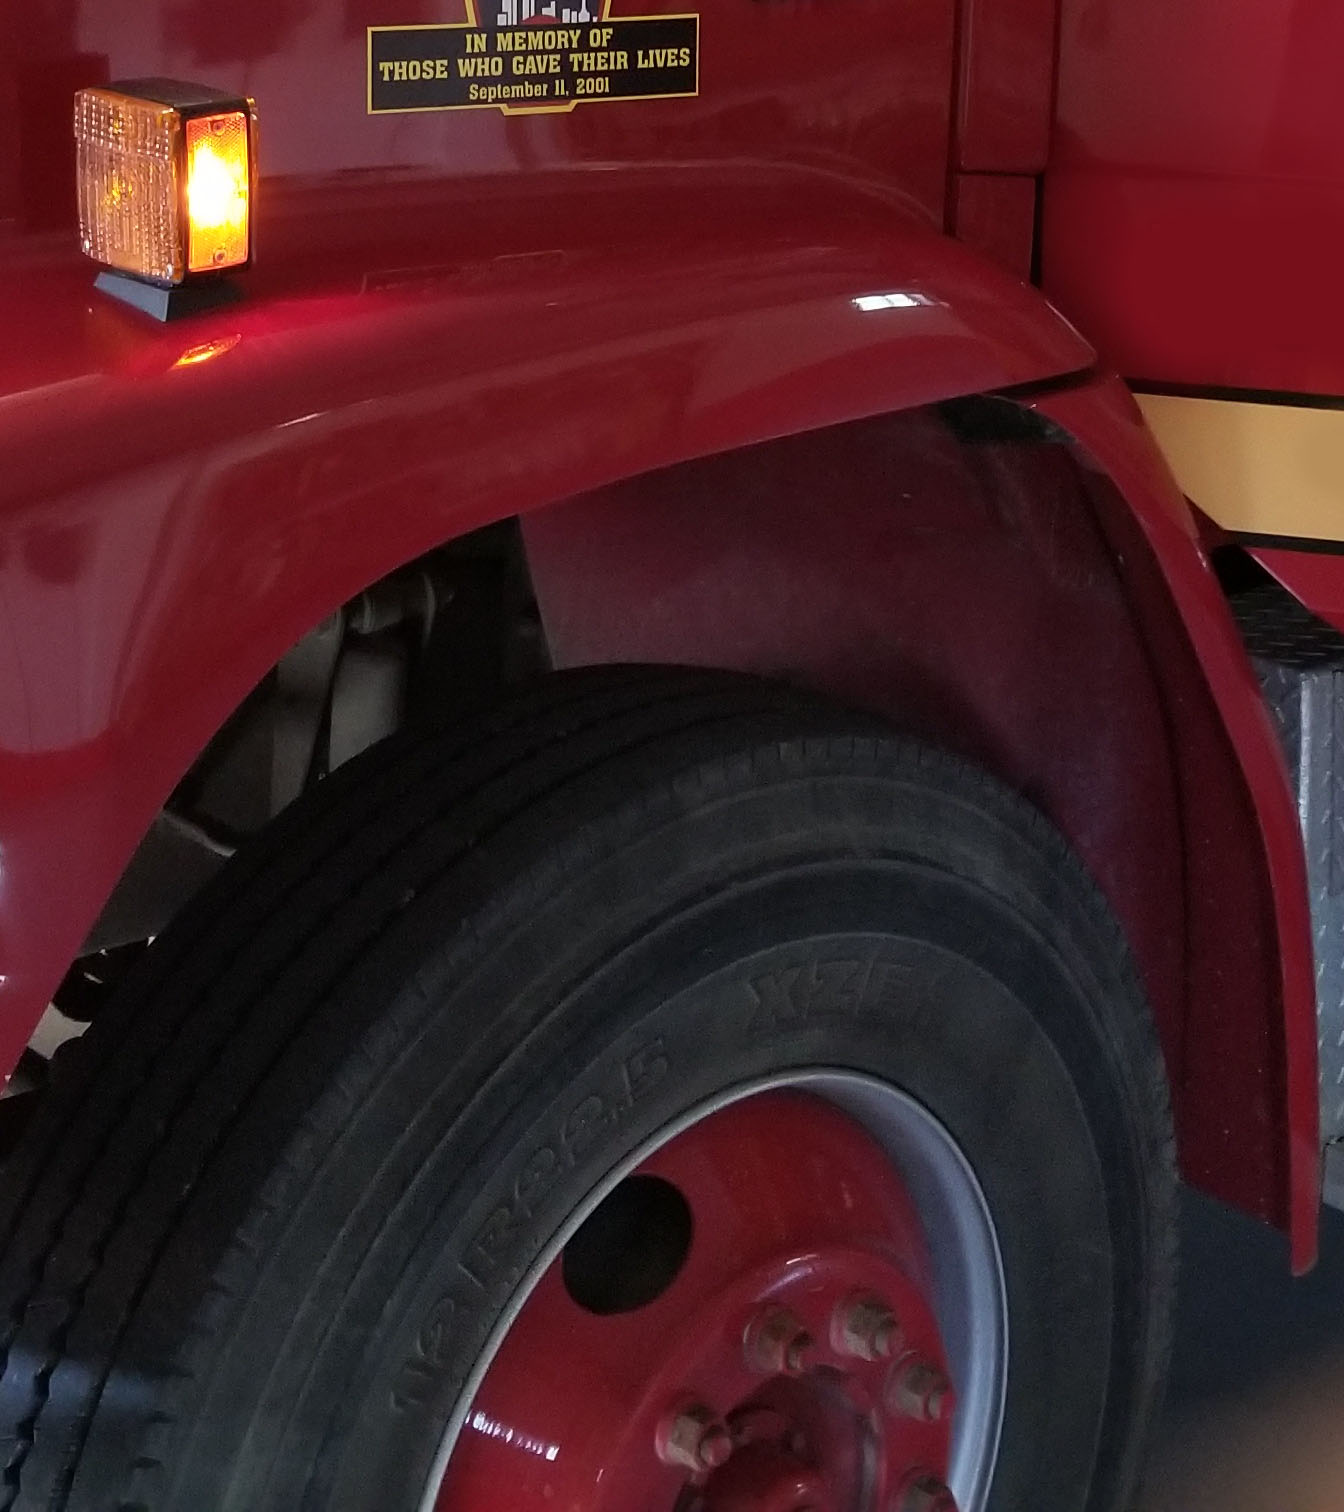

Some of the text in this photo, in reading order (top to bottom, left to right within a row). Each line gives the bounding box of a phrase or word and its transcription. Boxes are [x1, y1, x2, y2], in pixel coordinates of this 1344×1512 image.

[465, 28, 614, 54] IN MEMORY OF
[379, 47, 691, 82] THOSE WHO GAVE THEIR LIVES
[468, 77, 610, 103] September 11, 2001
